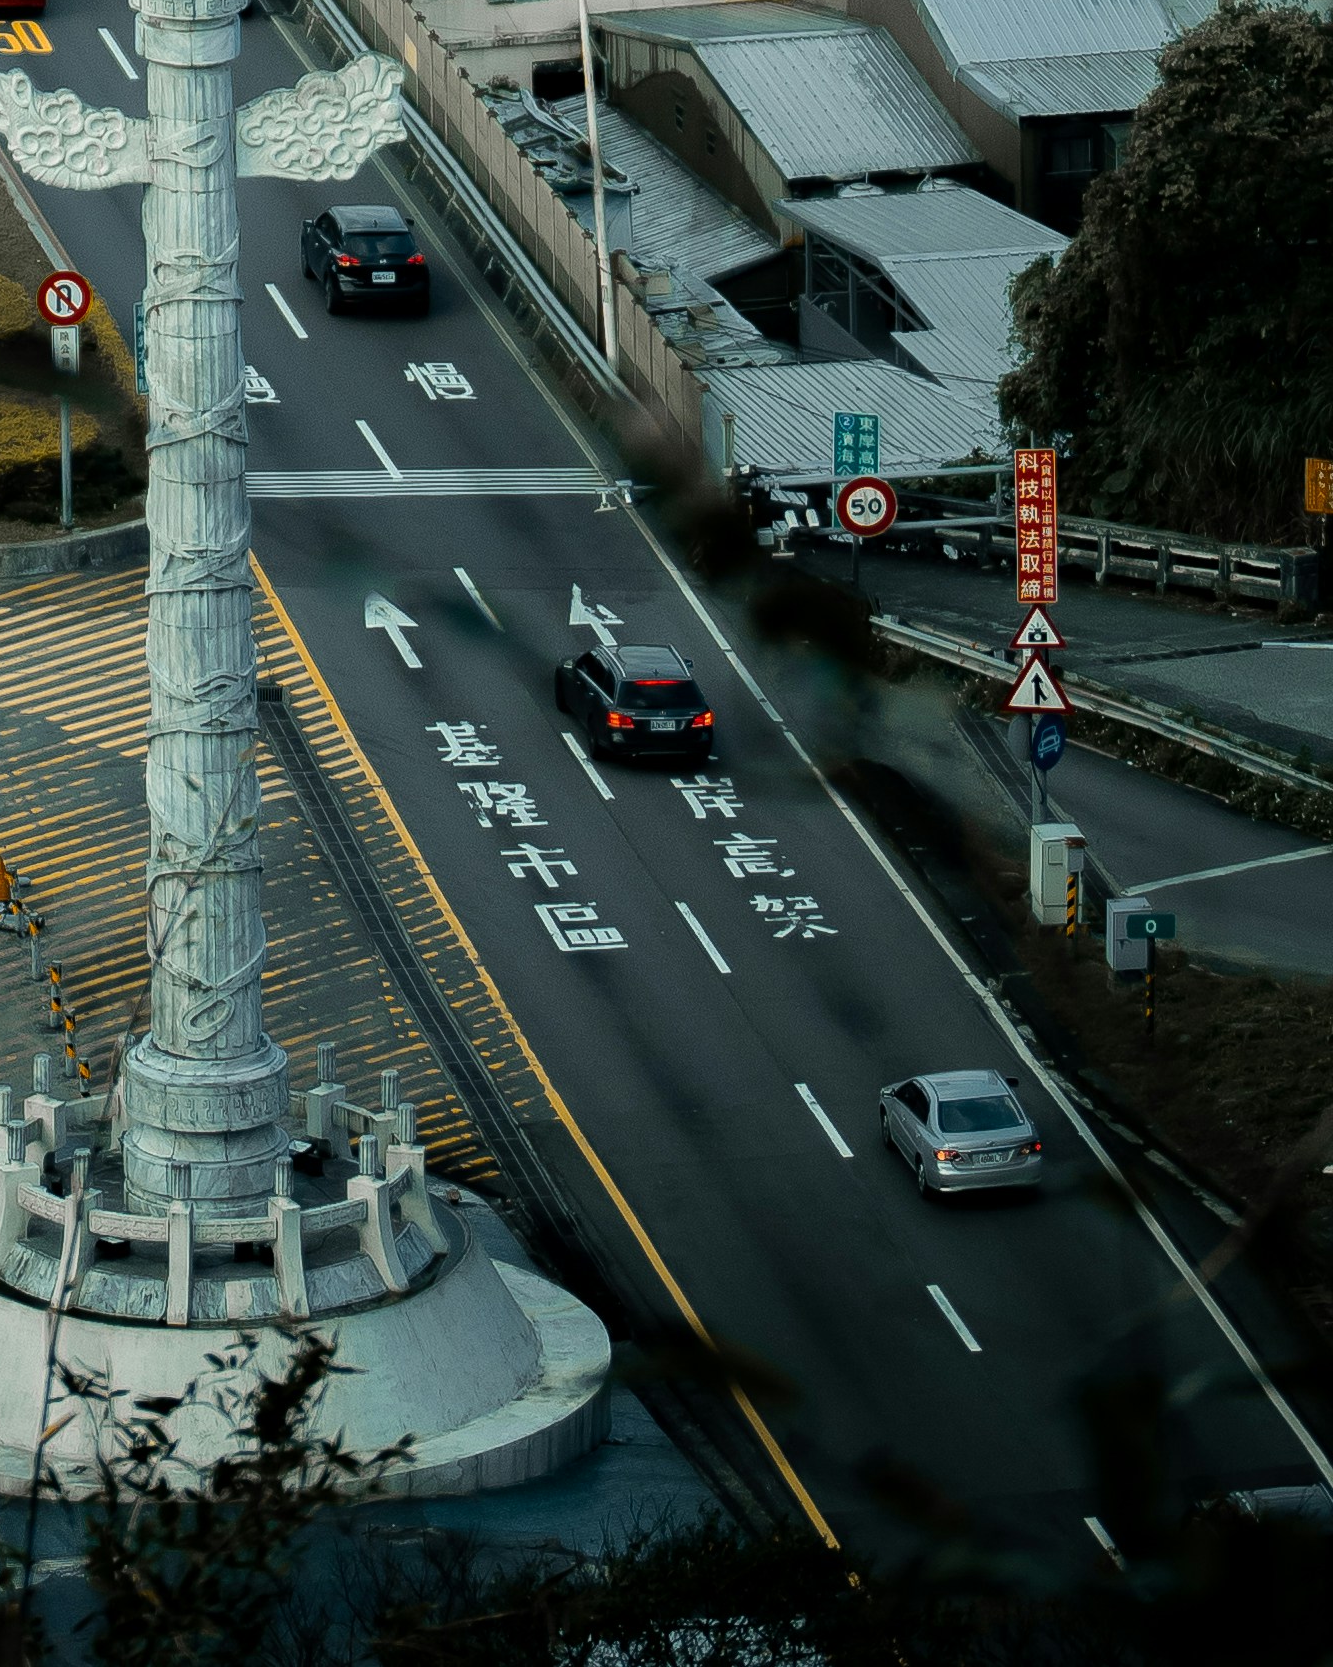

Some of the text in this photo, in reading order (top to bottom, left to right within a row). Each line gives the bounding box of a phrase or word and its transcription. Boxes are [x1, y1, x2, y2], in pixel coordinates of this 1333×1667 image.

[404, 362, 476, 401] 慢
[849, 497, 882, 517] 50
[1019, 452, 1041, 600] 科技執法取締
[425, 721, 628, 952] 基隆市區
[670, 773, 839, 939] 岸高架
[1145, 919, 1157, 933] 0
